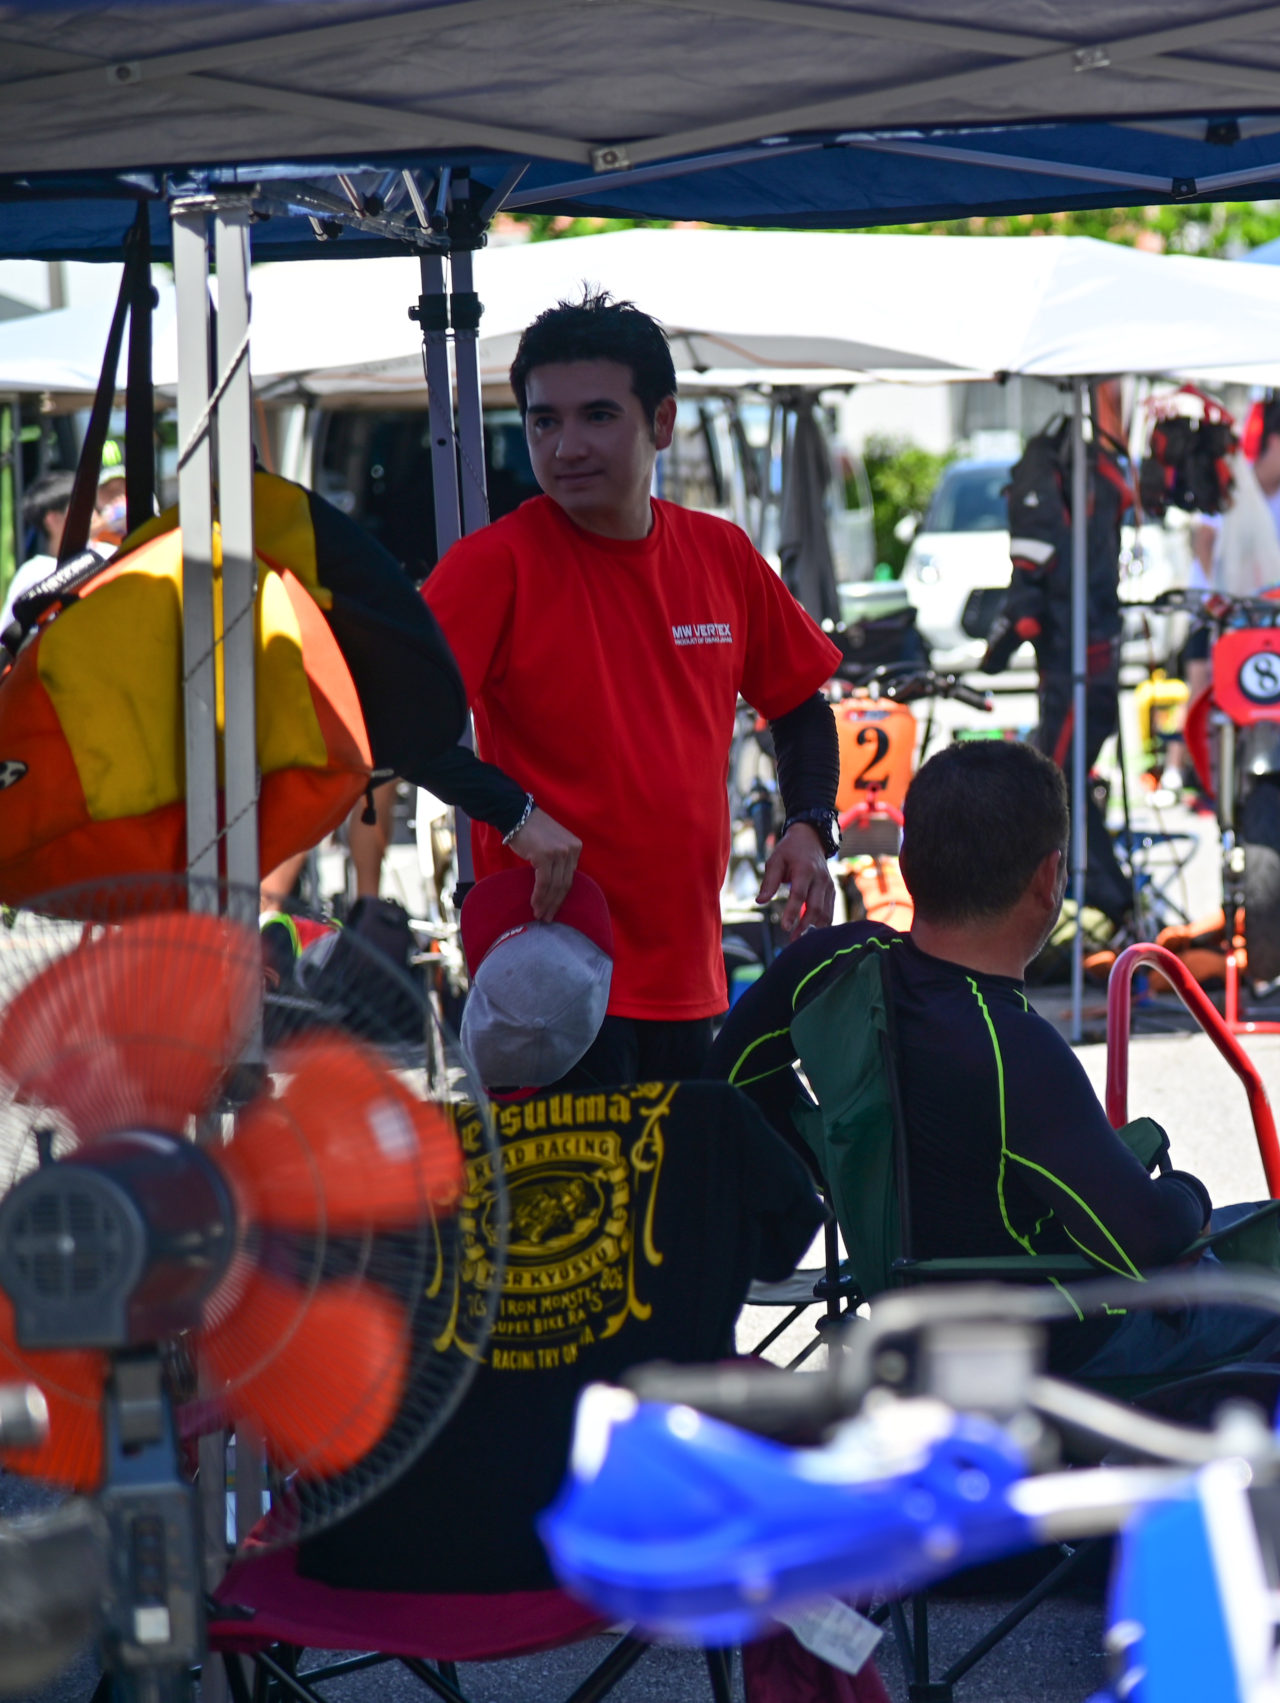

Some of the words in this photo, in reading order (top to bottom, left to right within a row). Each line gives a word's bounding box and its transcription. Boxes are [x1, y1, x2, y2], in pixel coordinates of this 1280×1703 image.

[672, 624, 693, 639] MW
[693, 623, 732, 637] VERTEX
[1253, 657, 1279, 692] 8
[854, 726, 890, 790] 2
[535, 1138, 612, 1160] RACING
[531, 1247, 608, 1287] KYUSYU
[500, 1297, 537, 1316] IRON
